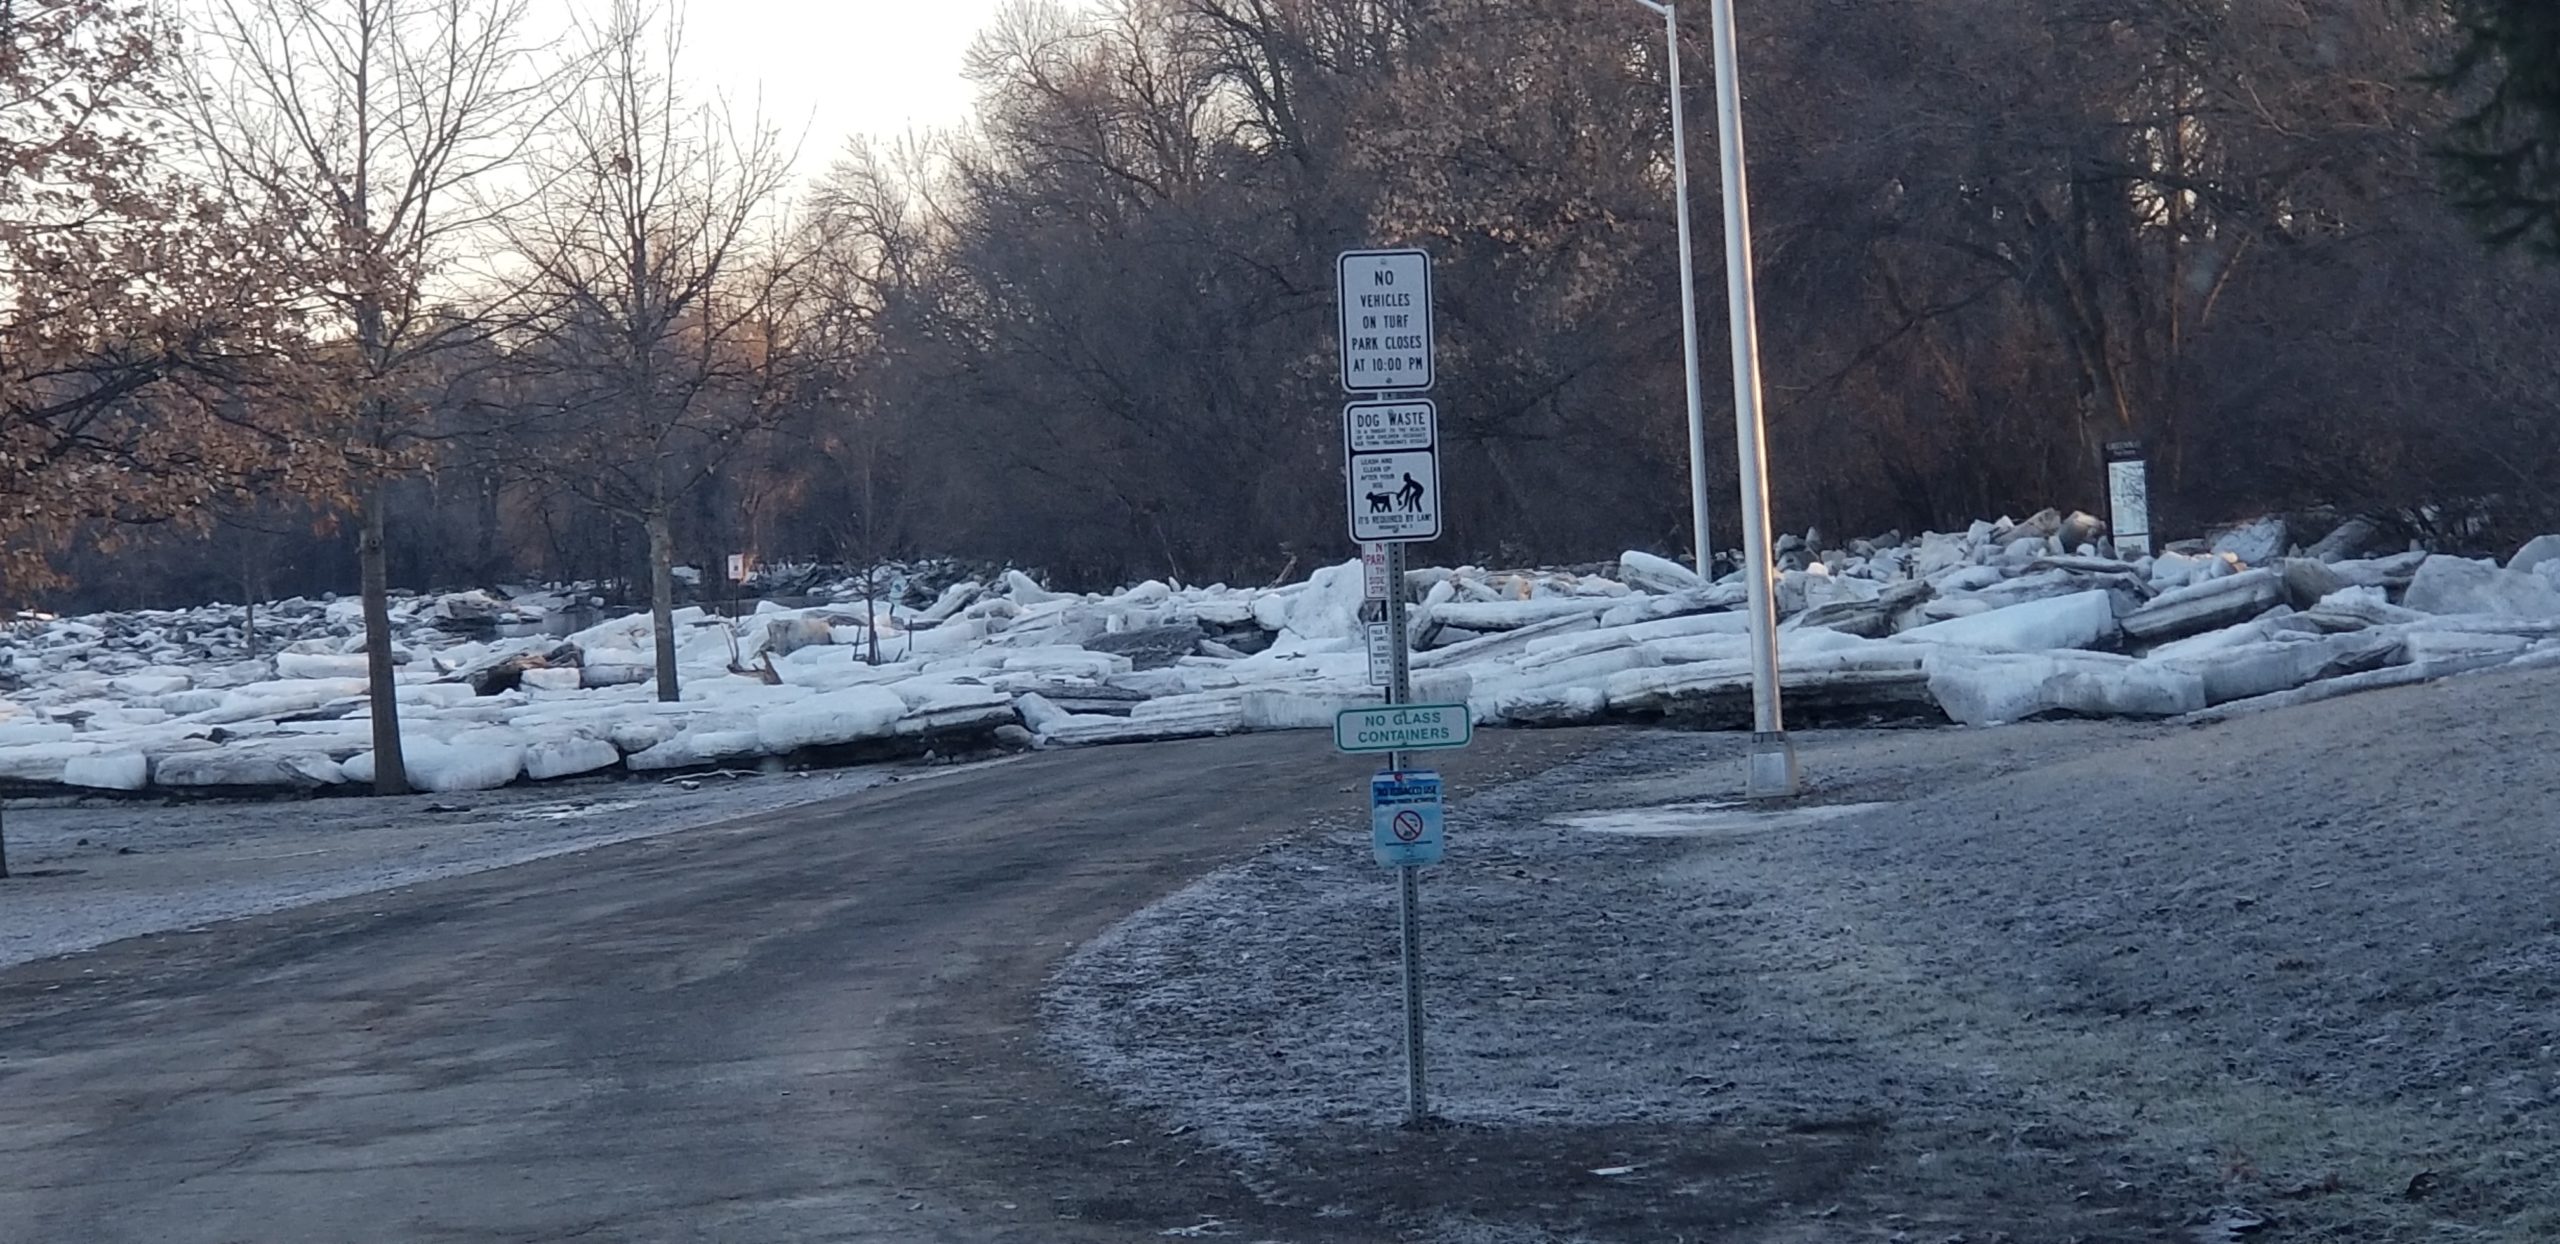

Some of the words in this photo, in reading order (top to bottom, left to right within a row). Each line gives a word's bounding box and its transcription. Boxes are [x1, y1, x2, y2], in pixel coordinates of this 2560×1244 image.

[1374, 270, 1394, 286] NO
[1360, 293, 1411, 308] VEHICLES
[1362, 315, 1377, 329] ON
[1384, 314, 1409, 328] TURF
[1351, 337, 1379, 351] PARK
[1385, 335, 1422, 350] CLOSES
[1353, 358, 1365, 372] AT
[1372, 357, 1402, 372] 10:00
[1409, 357, 1423, 370] PM
[1356, 414, 1380, 428] DOG
[1388, 412, 1426, 426] WASTE
[1371, 515, 1403, 524] REQUIRED
[1366, 554, 1385, 565] PARK
[1365, 715, 1386, 727] NO
[1393, 712, 1441, 726] GLASS
[1358, 727, 1450, 743] CONTAINERS
[1390, 786, 1422, 796] TOBACCO
[1423, 785, 1437, 794] USE
